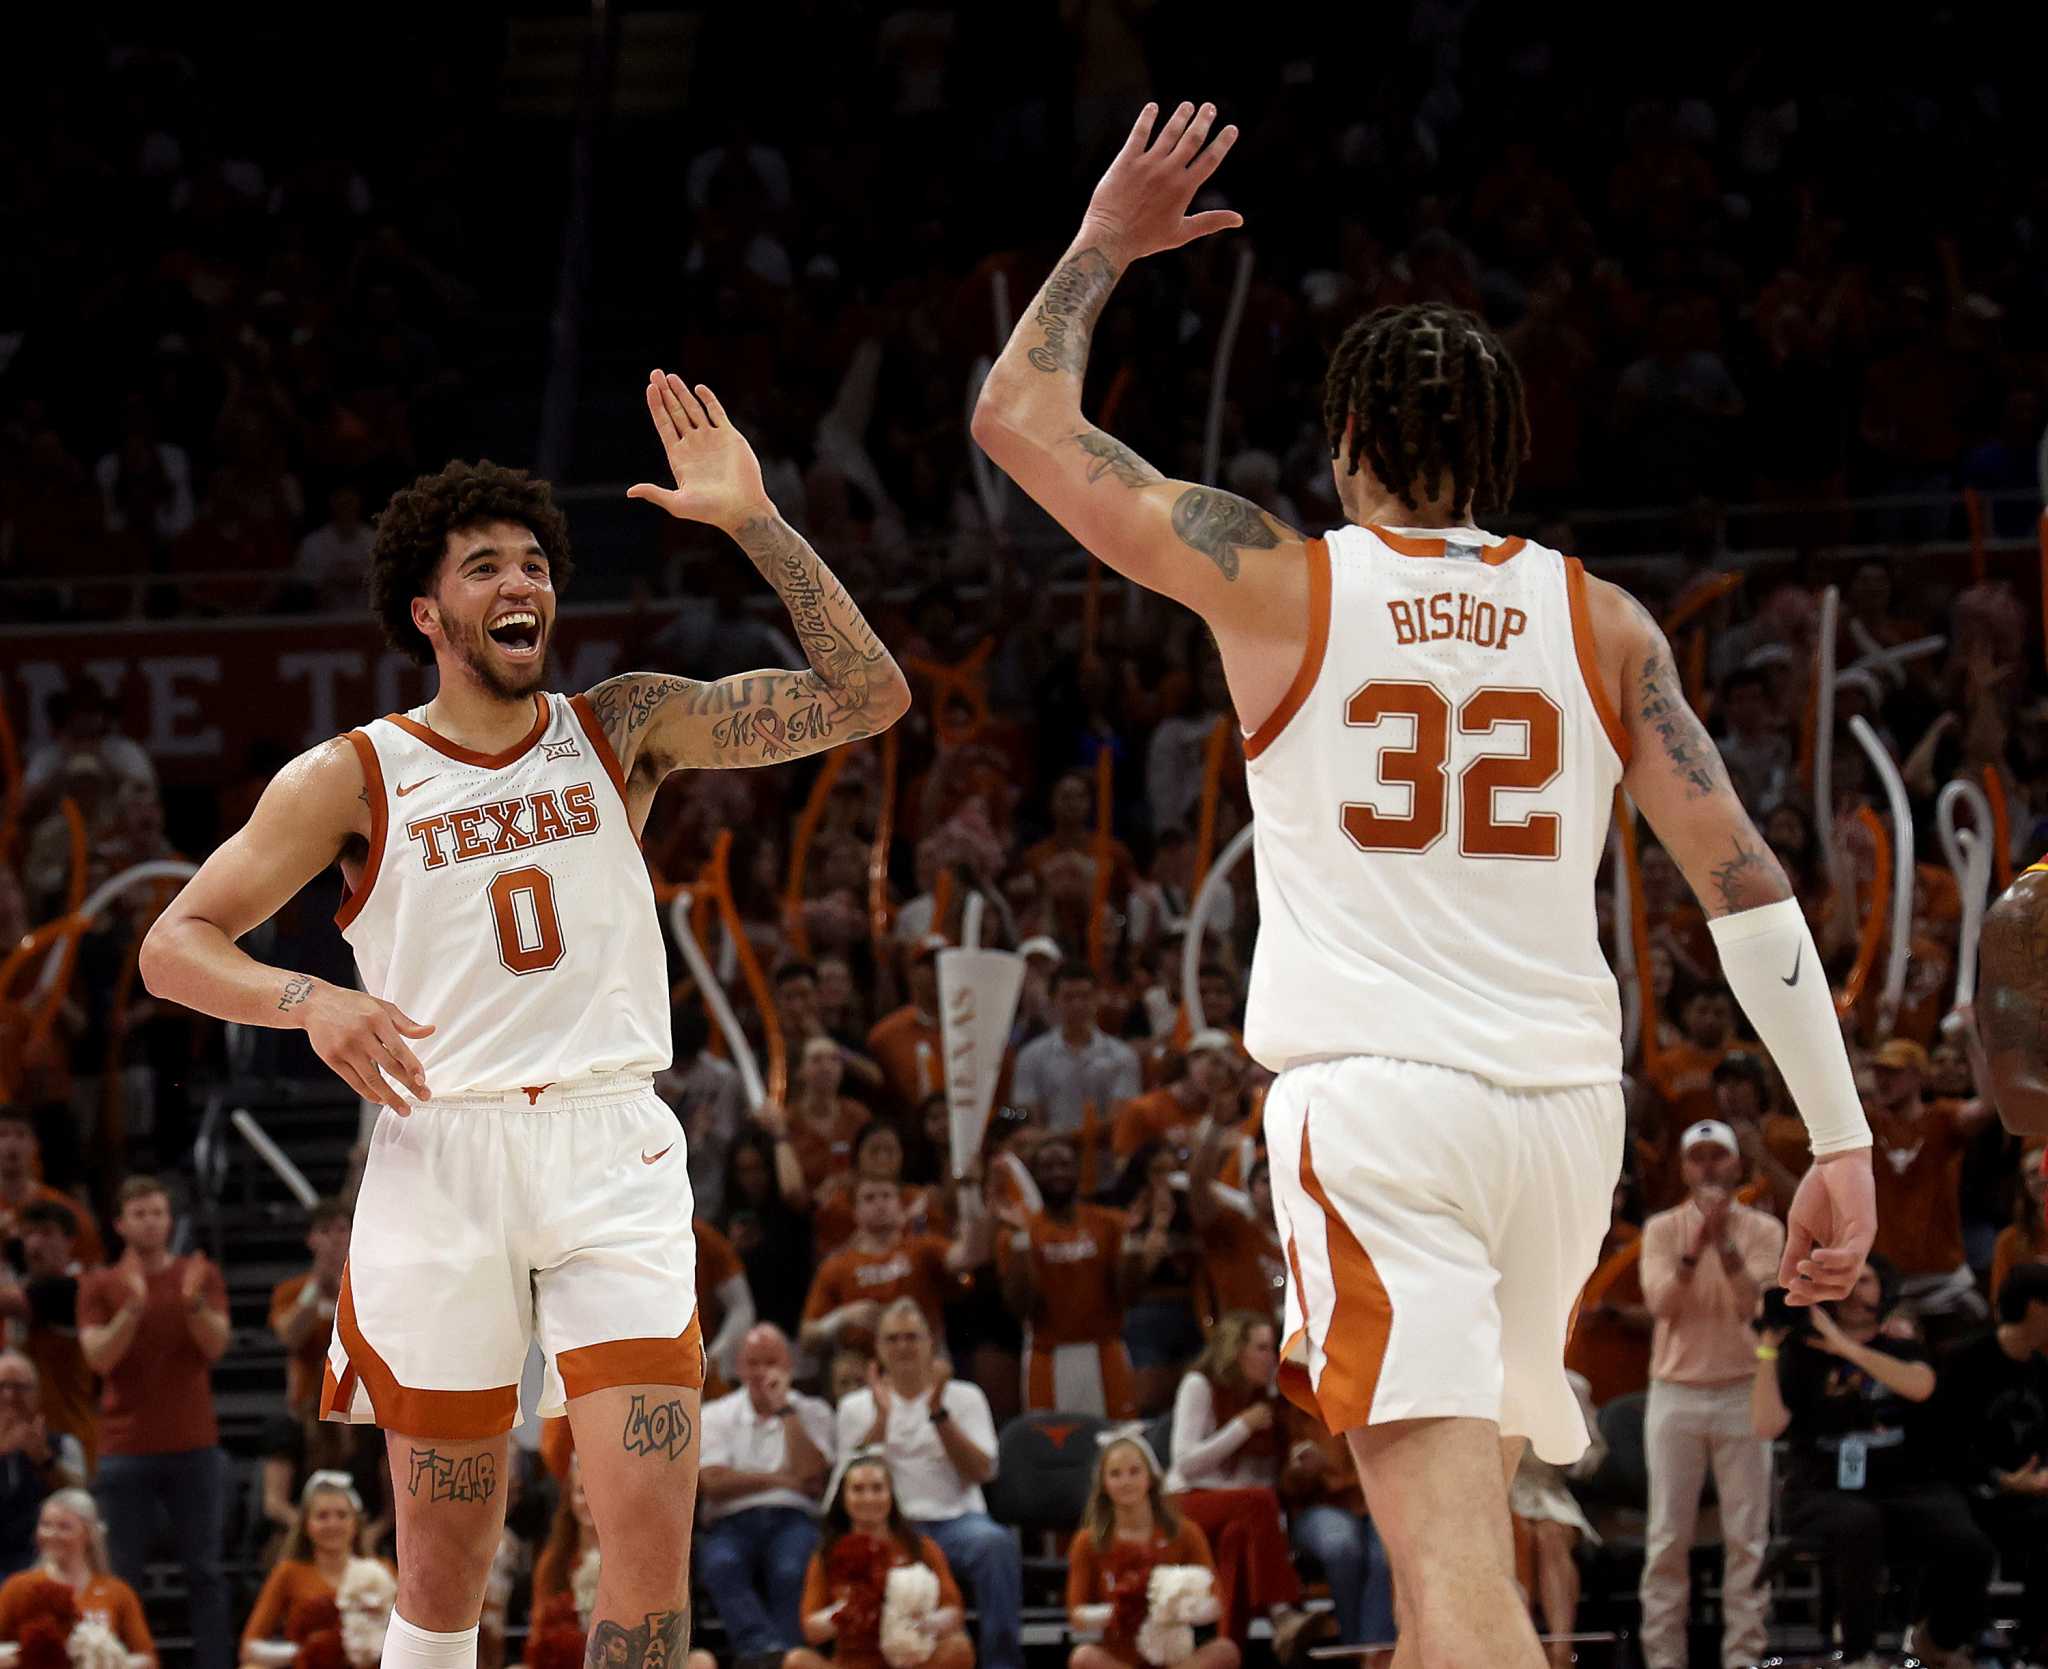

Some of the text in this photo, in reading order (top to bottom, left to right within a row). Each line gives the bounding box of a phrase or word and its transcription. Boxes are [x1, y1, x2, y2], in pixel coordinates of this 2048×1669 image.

[1386, 592, 1528, 650] BISHOP
[1340, 678, 1563, 861] 32
[406, 782, 600, 871] TEXAS
[486, 864, 567, 976] 0
[623, 1394, 692, 1461] GOD
[407, 1446, 496, 1504] FEAR
